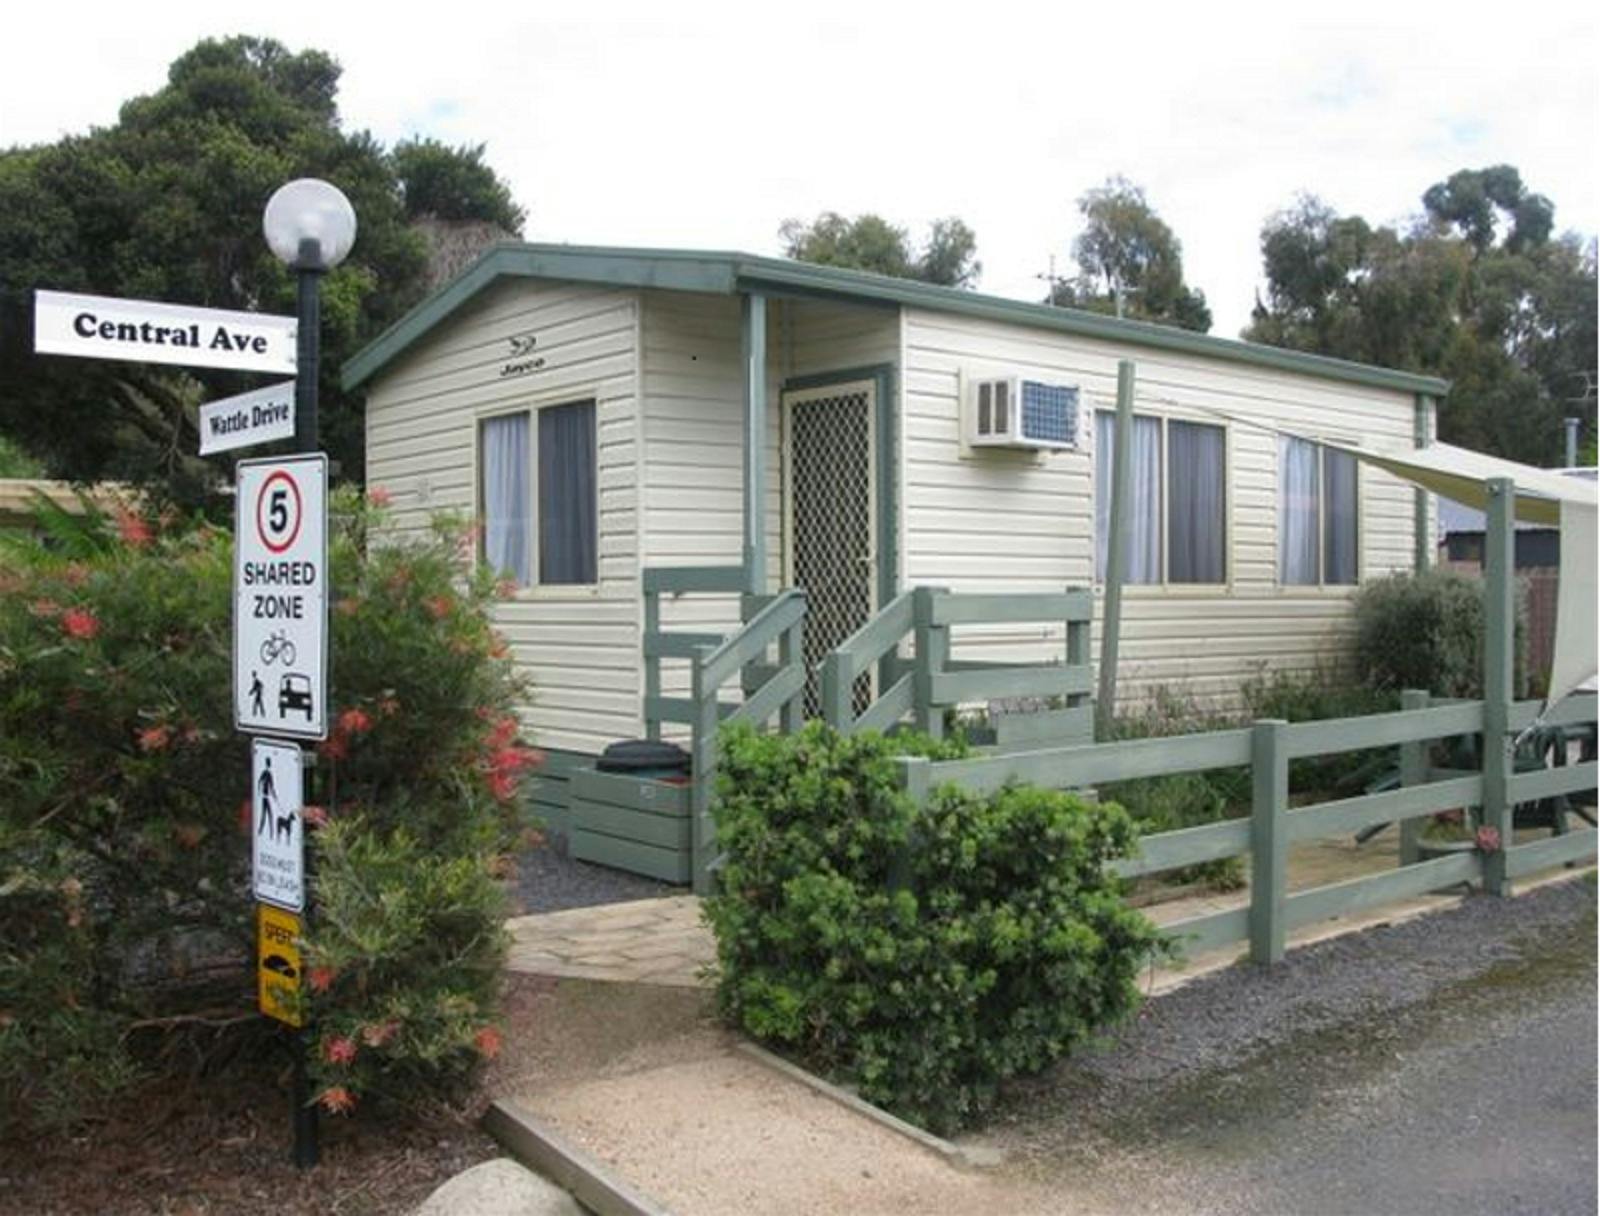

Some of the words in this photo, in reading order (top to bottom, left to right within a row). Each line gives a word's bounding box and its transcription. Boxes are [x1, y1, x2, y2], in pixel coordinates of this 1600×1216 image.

[74, 312, 200, 348] Central
[209, 326, 268, 354] Ave
[209, 410, 248, 436] Wattle
[252, 402, 289, 428] Drive
[269, 491, 288, 533] 5
[244, 562, 315, 586] SHARED
[253, 595, 303, 619] ZONE
